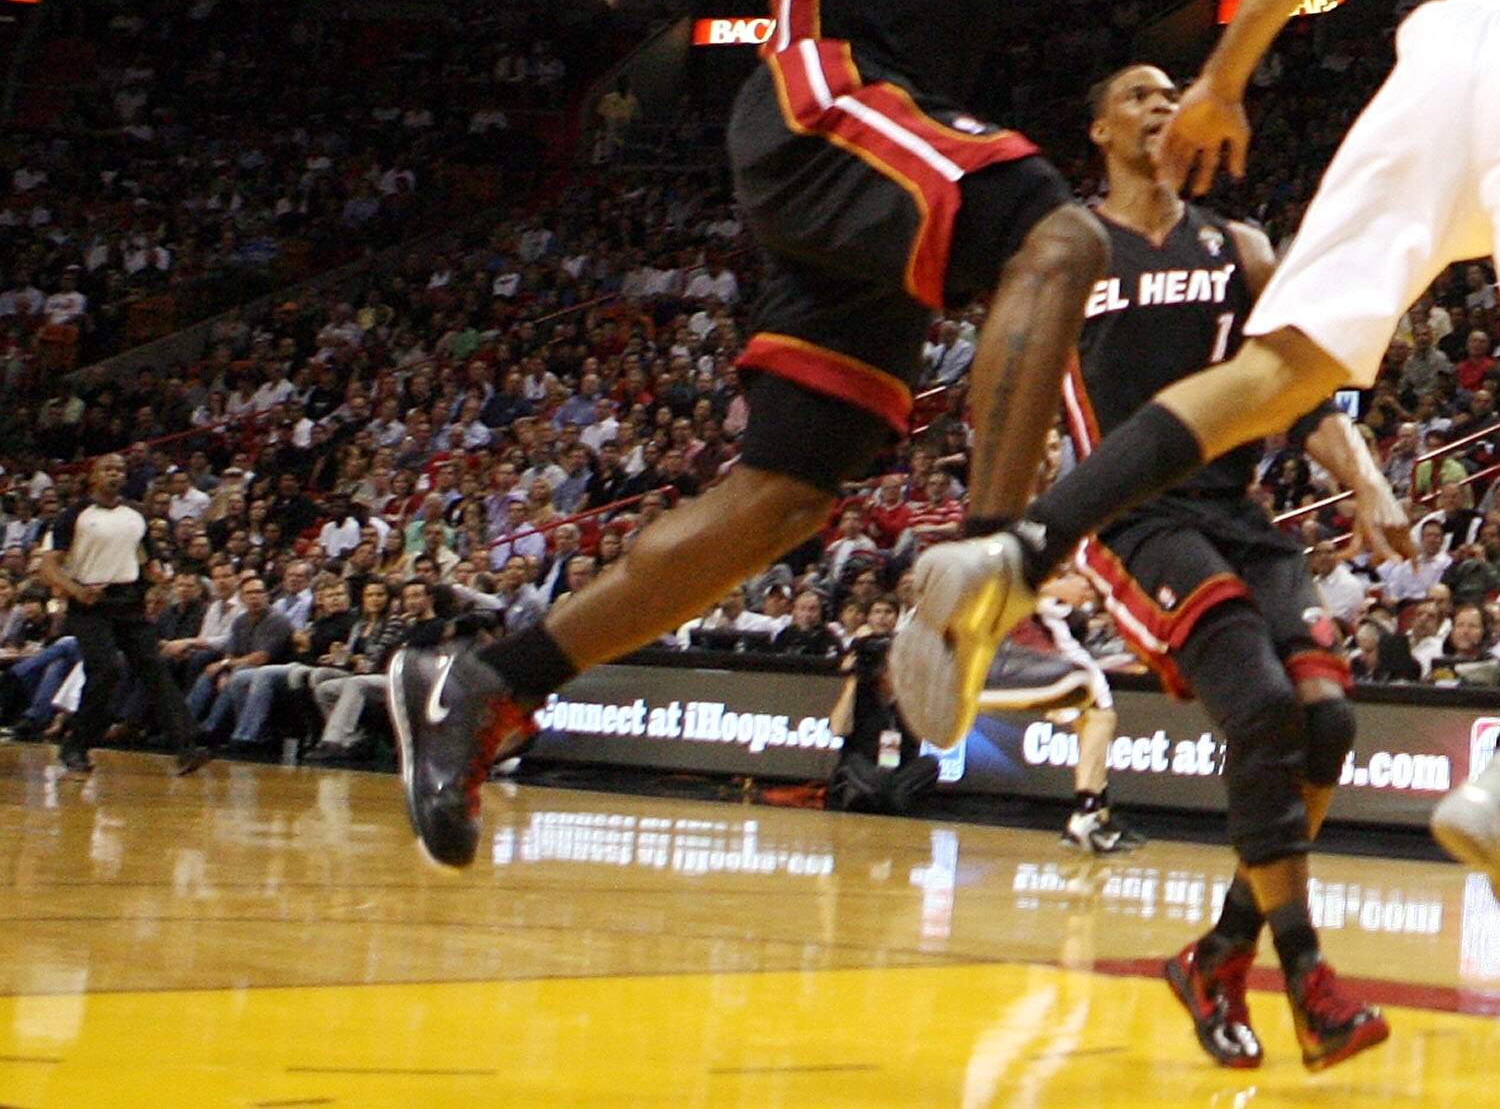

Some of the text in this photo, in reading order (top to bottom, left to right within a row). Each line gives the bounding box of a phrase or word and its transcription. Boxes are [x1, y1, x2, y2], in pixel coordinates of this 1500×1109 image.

[1084, 262, 1237, 320] EL HEAT
[1210, 312, 1237, 364] 1
[648, 701, 682, 739] at
[682, 701, 845, 753] iHoops.co
[1022, 720, 1171, 772] Coect
[1172, 731, 1217, 776] at
